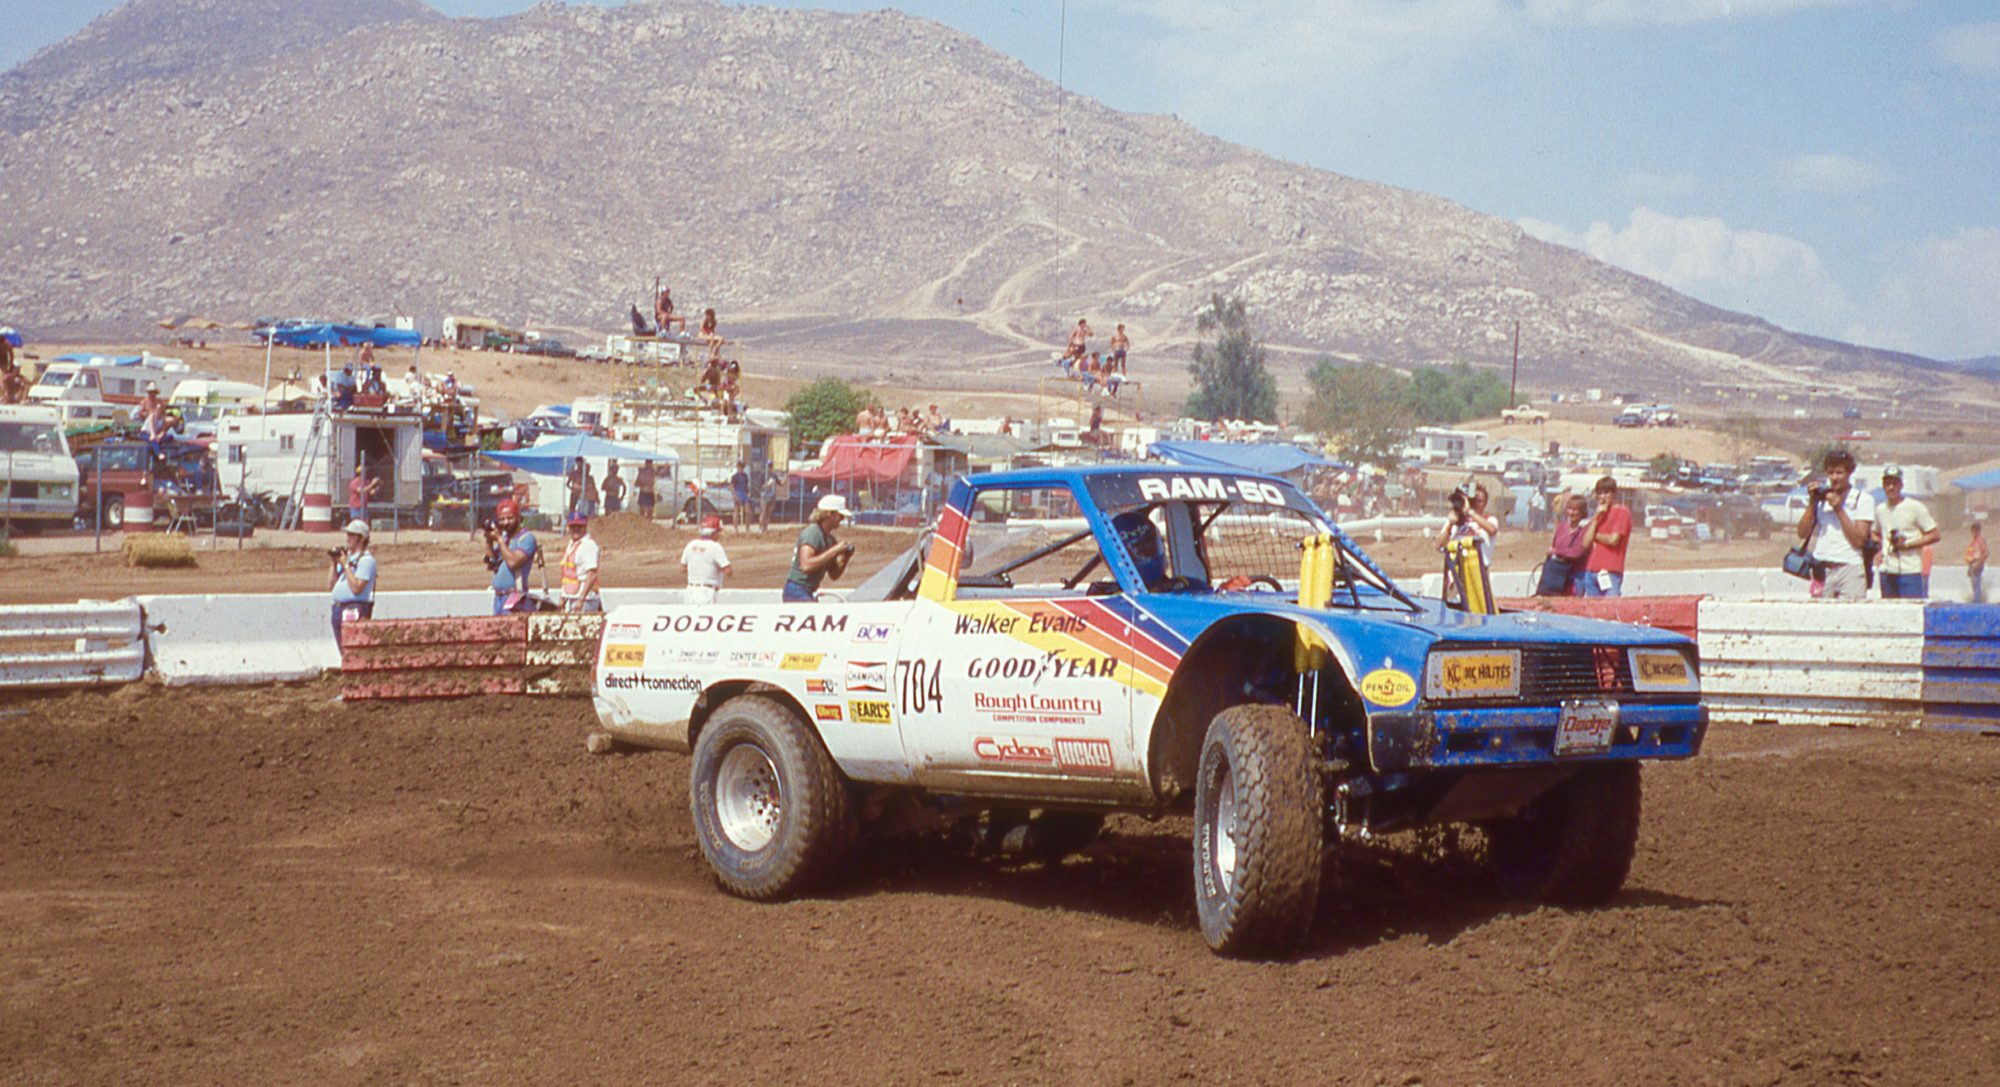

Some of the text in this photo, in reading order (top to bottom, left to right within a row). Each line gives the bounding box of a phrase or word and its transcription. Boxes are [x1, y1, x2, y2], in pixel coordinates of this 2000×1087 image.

[652, 615, 757, 632] DODGE
[774, 615, 848, 632] RAM
[954, 613, 1088, 634] Walker Evans
[898, 658, 943, 715] 704
[857, 702, 890, 718] EARL'S
[974, 692, 1102, 715] Rough Country
[992, 714, 1086, 725] COMPETITION COMPONENTS
[1564, 714, 1612, 735] Dodge
[974, 736, 1052, 762] Cyclone
